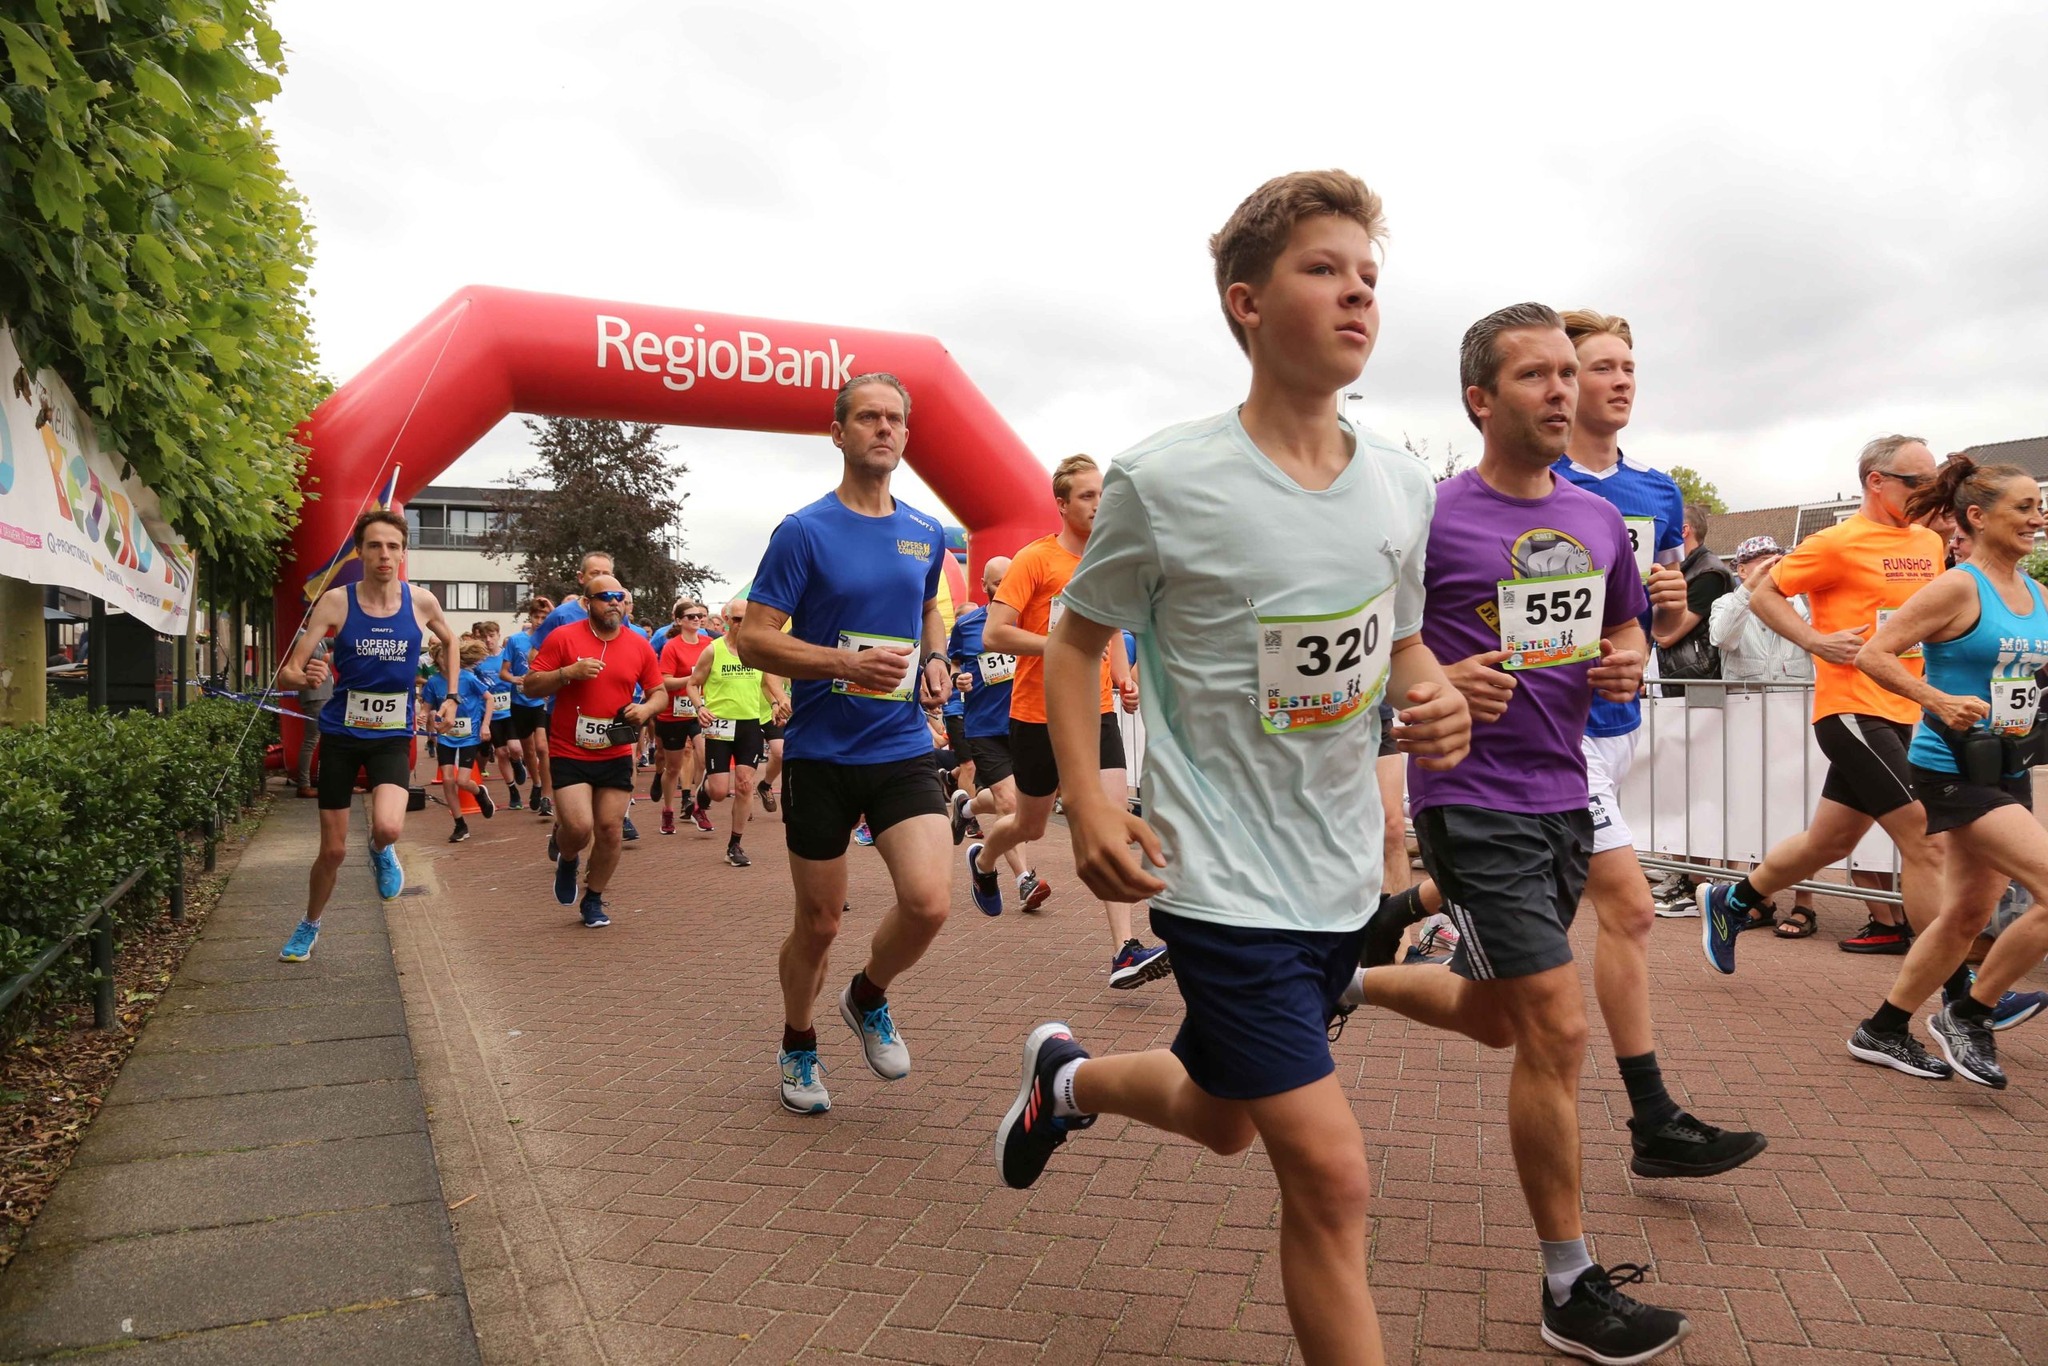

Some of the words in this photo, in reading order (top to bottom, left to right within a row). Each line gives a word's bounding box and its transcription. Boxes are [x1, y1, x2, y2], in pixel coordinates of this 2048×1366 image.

[596, 314, 855, 391] RegioBank
[1882, 558, 1932, 570] RUNSHOP
[1525, 587, 1592, 626] 552
[356, 639, 397, 648] LOPERS
[1296, 613, 1379, 677] 320
[1507, 637, 1558, 652] BESTERD
[356, 648, 396, 656] COMPANY
[987, 654, 1016, 669] 513
[493, 694, 508, 703] 19
[1268, 689, 1280, 698] DE
[1269, 691, 1343, 710] BESTERD
[360, 698, 401, 712] 105
[453, 720, 466, 729] 29
